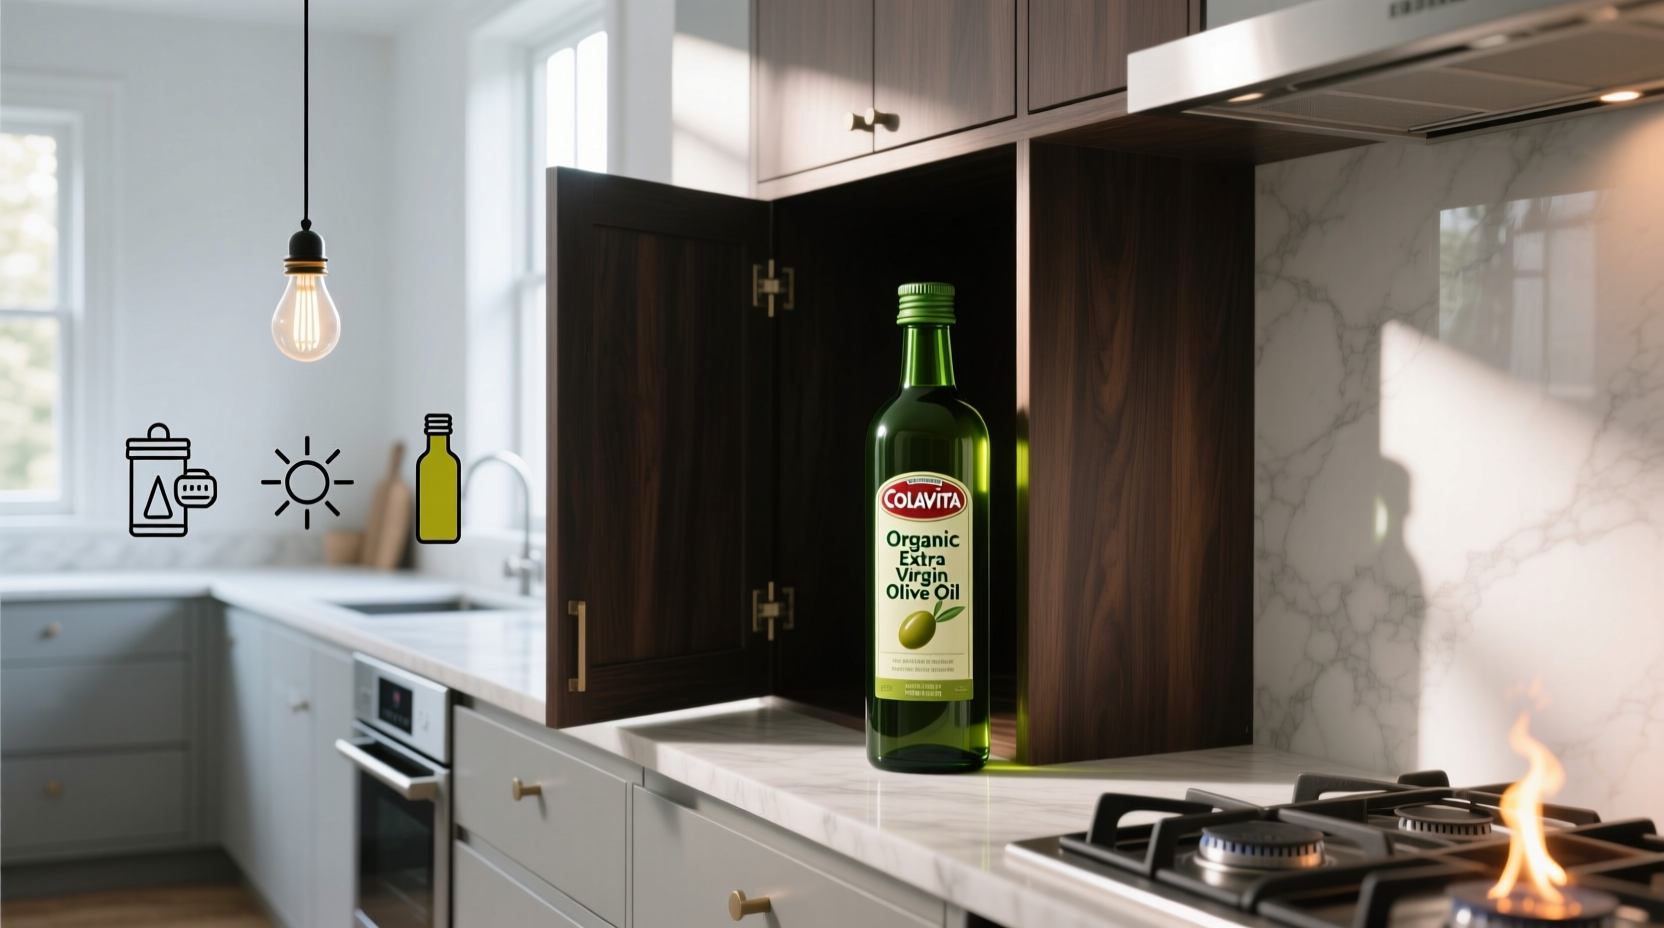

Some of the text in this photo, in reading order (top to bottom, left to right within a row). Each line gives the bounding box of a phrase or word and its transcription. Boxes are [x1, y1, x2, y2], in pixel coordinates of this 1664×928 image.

[886, 530, 960, 552] Organic
[899, 550, 945, 567] Extra
[895, 567, 948, 587] Virgin
[886, 583, 960, 600] Olive Oil
